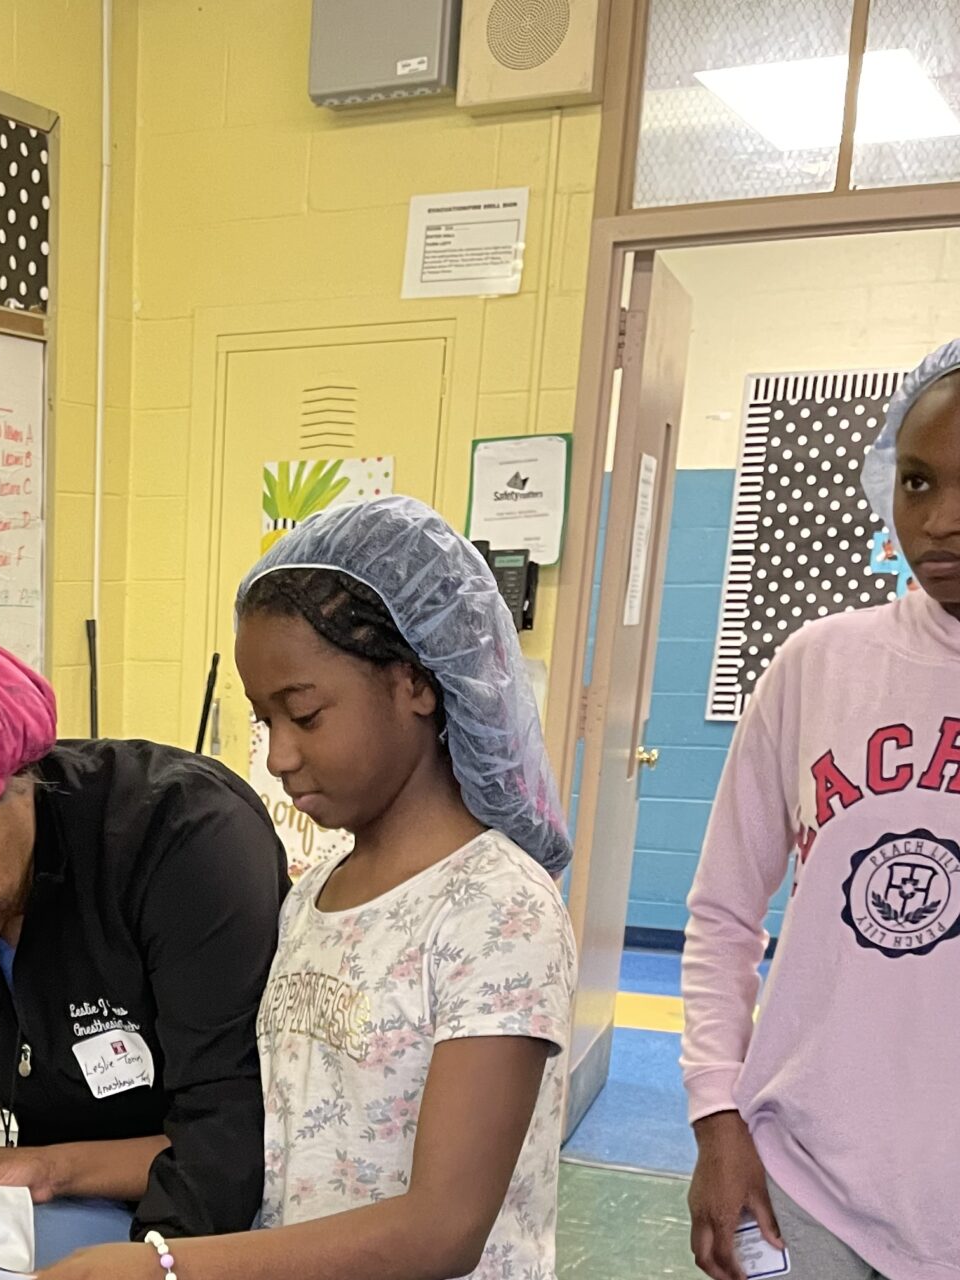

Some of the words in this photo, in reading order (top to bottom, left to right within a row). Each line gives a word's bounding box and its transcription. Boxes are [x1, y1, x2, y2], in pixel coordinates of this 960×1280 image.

[869, 841, 925, 867] PEACH
[931, 845, 960, 874] LILY
[855, 916, 887, 943] LILY
[893, 922, 946, 948] PEACH
[70, 1002, 100, 1018] Leslie
[85, 1056, 114, 1076] Leslie
